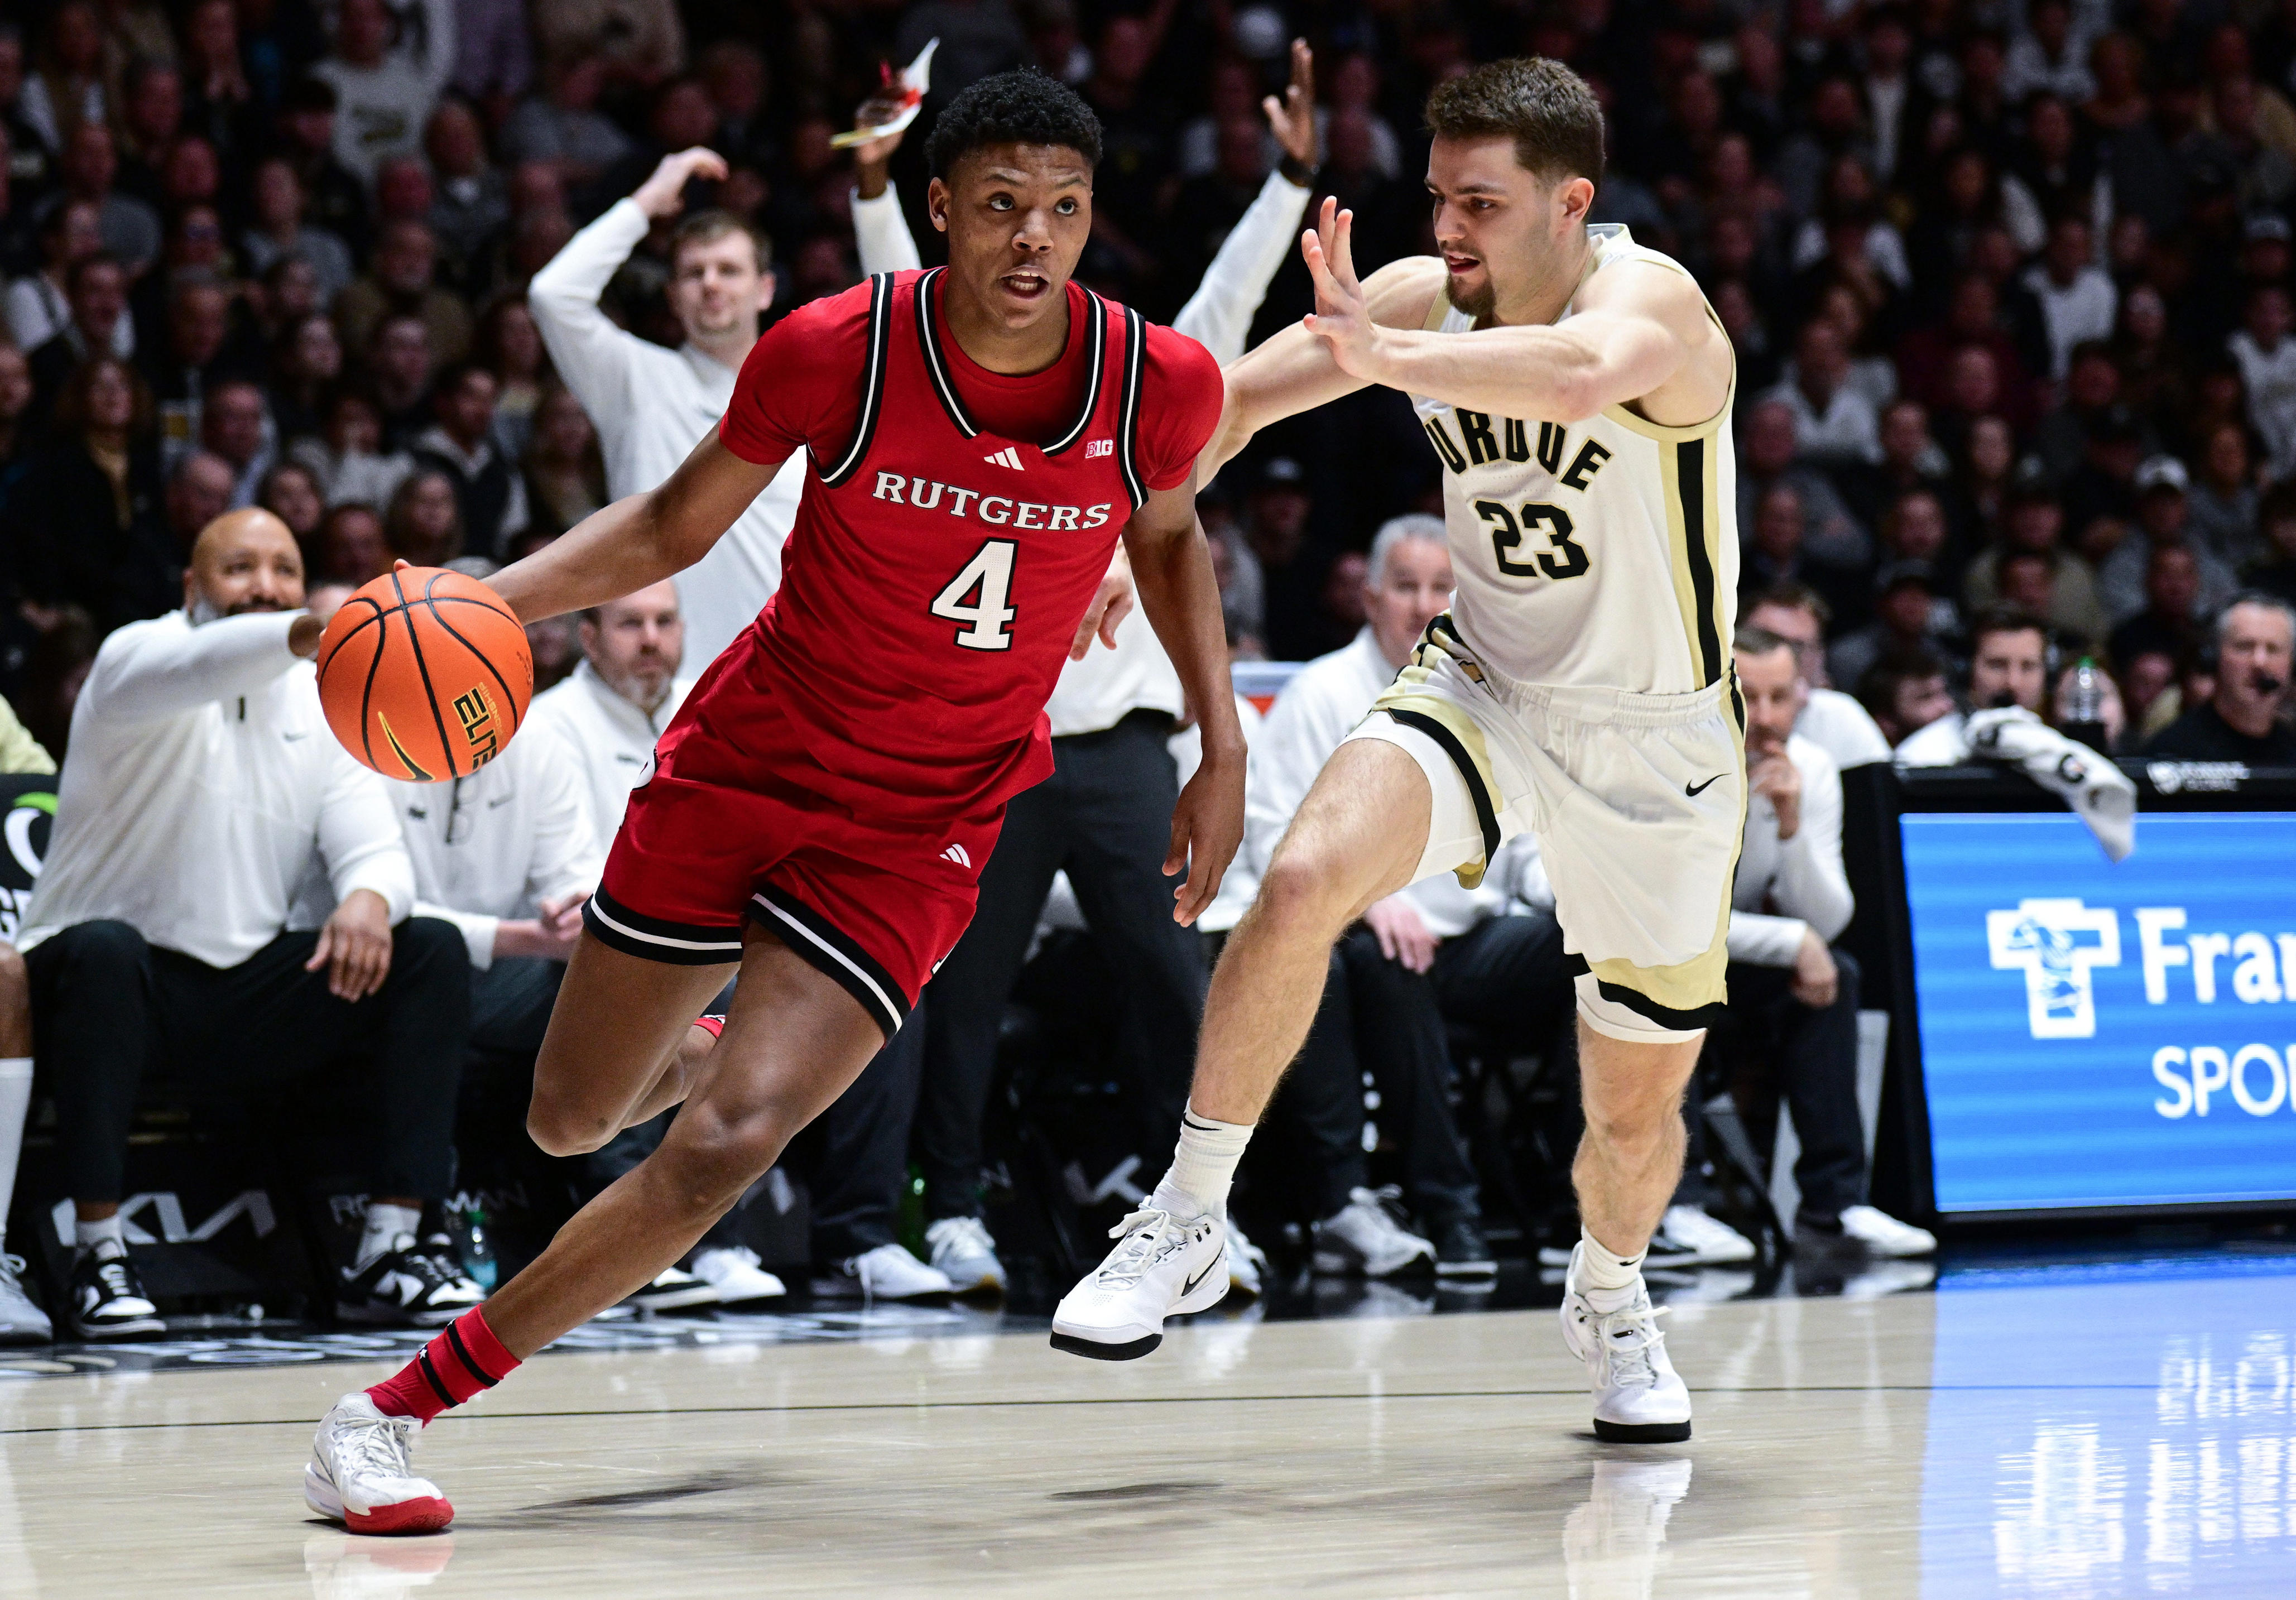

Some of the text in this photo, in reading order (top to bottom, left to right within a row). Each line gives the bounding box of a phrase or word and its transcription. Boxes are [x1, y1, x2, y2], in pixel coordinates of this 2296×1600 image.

[1423, 408, 1614, 493] URDUE
[872, 470, 1113, 531] RUTGERS
[1473, 498, 1592, 580] 23
[928, 537, 1019, 652] 4
[451, 686, 497, 771] ELITE
[2151, 1043, 2295, 1118] SPO
